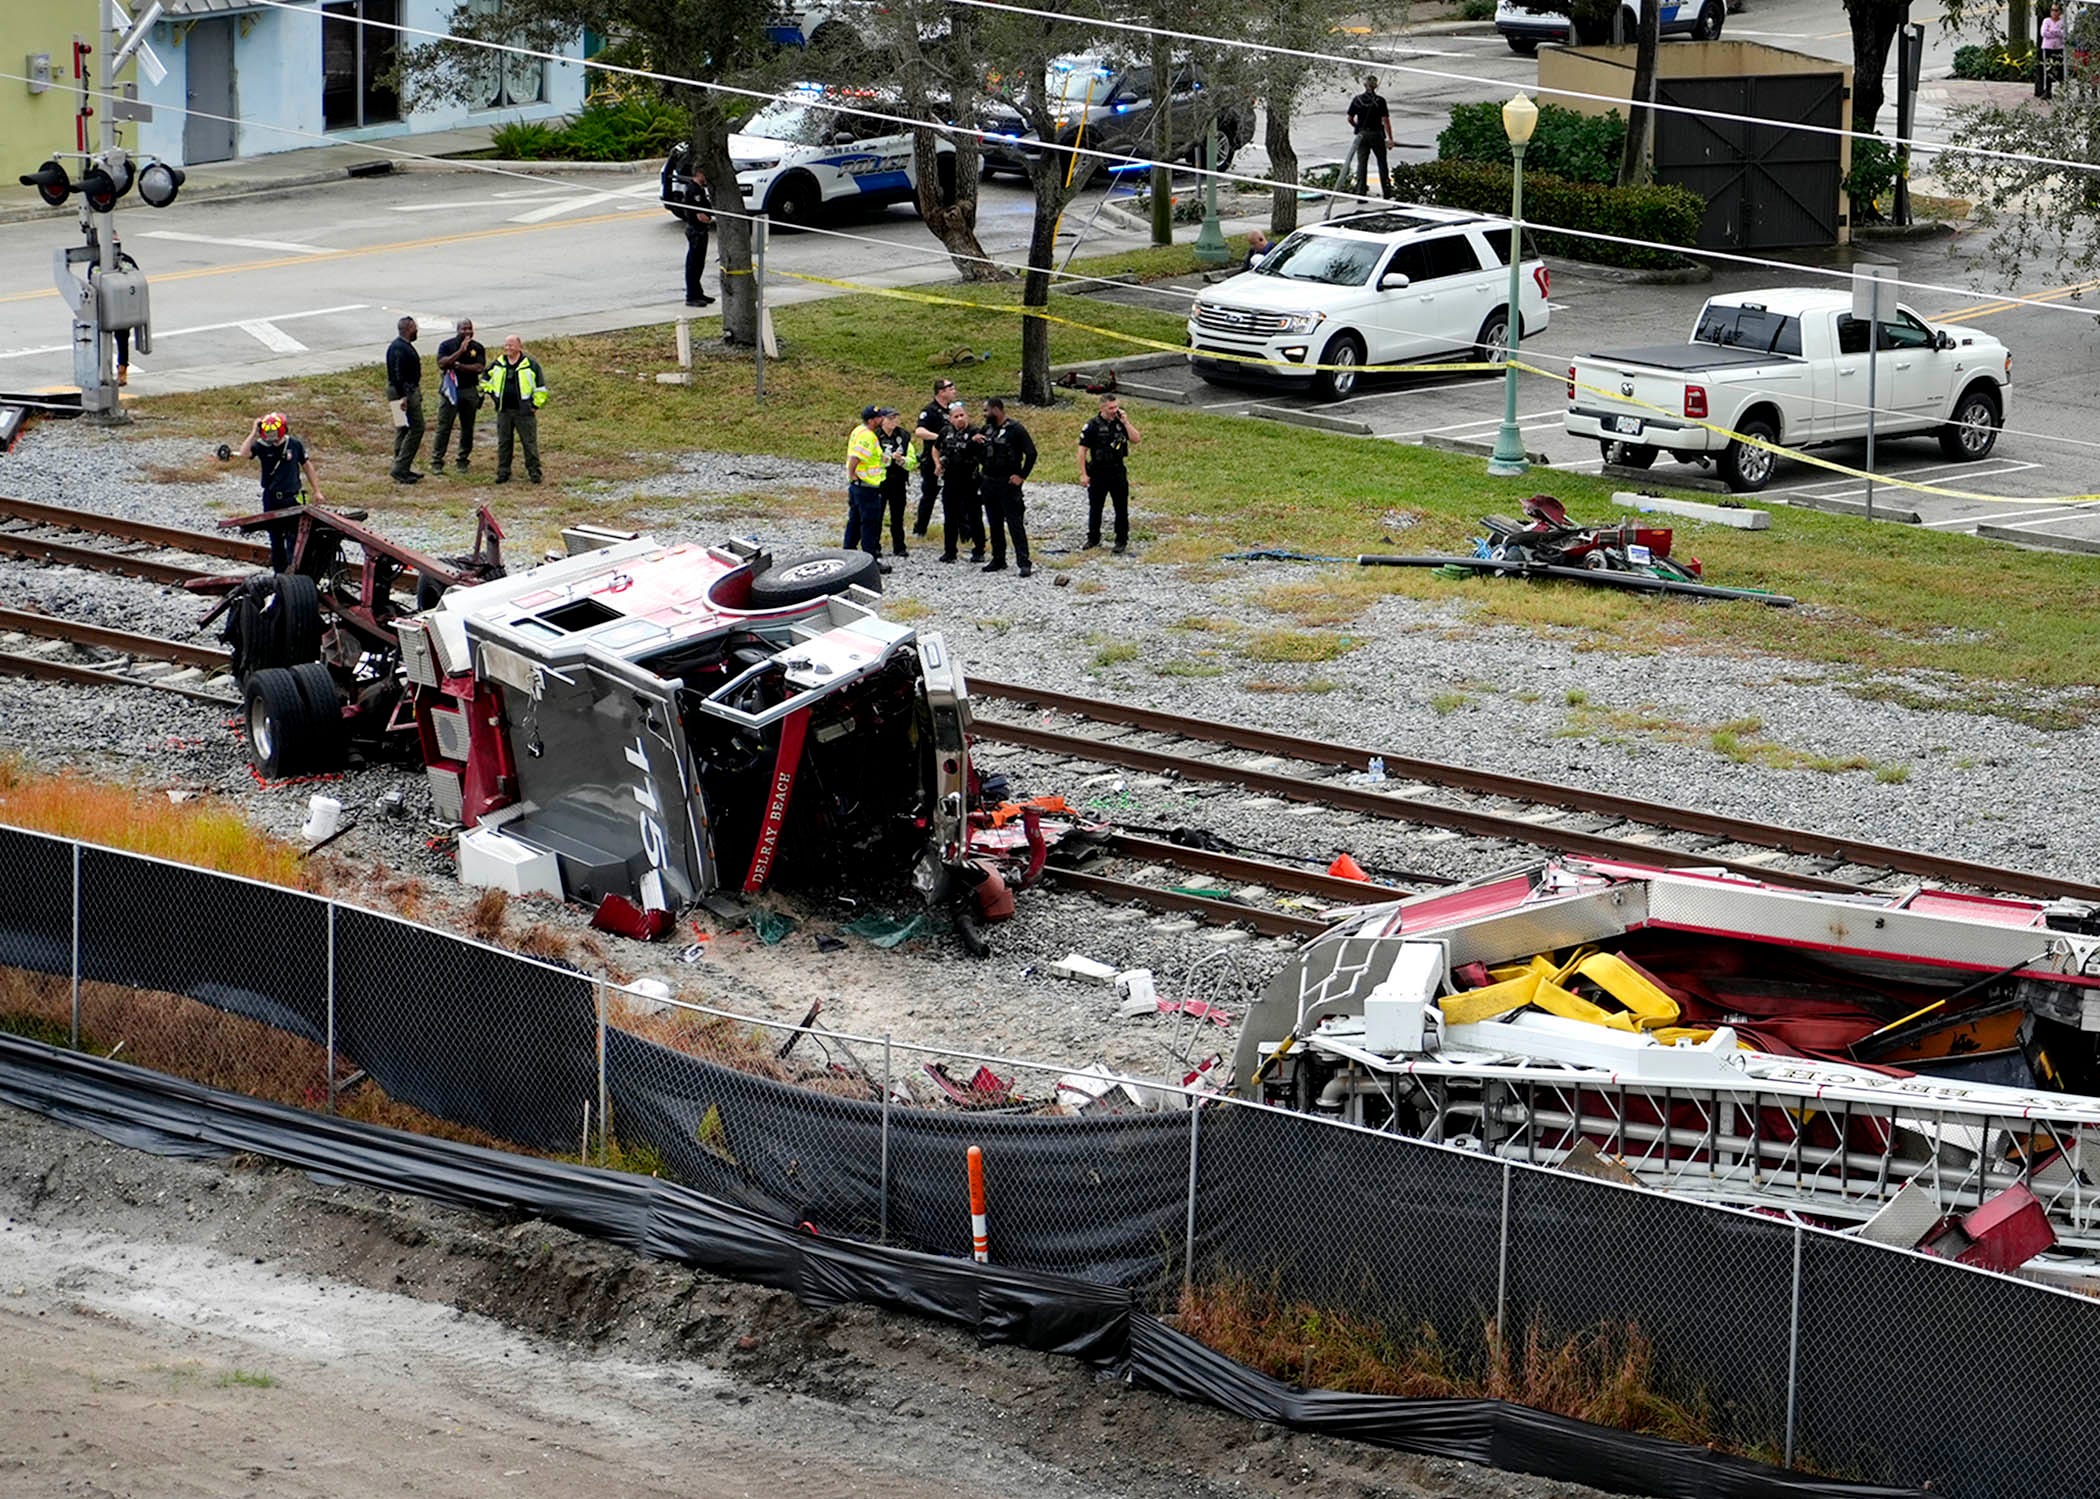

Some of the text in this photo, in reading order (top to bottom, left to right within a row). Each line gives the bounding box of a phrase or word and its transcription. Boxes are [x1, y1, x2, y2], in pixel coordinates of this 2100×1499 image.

[836, 153, 912, 178] POLICE
[129, 285, 136, 296] 3
[751, 771, 791, 883] DELRAY BEACH
